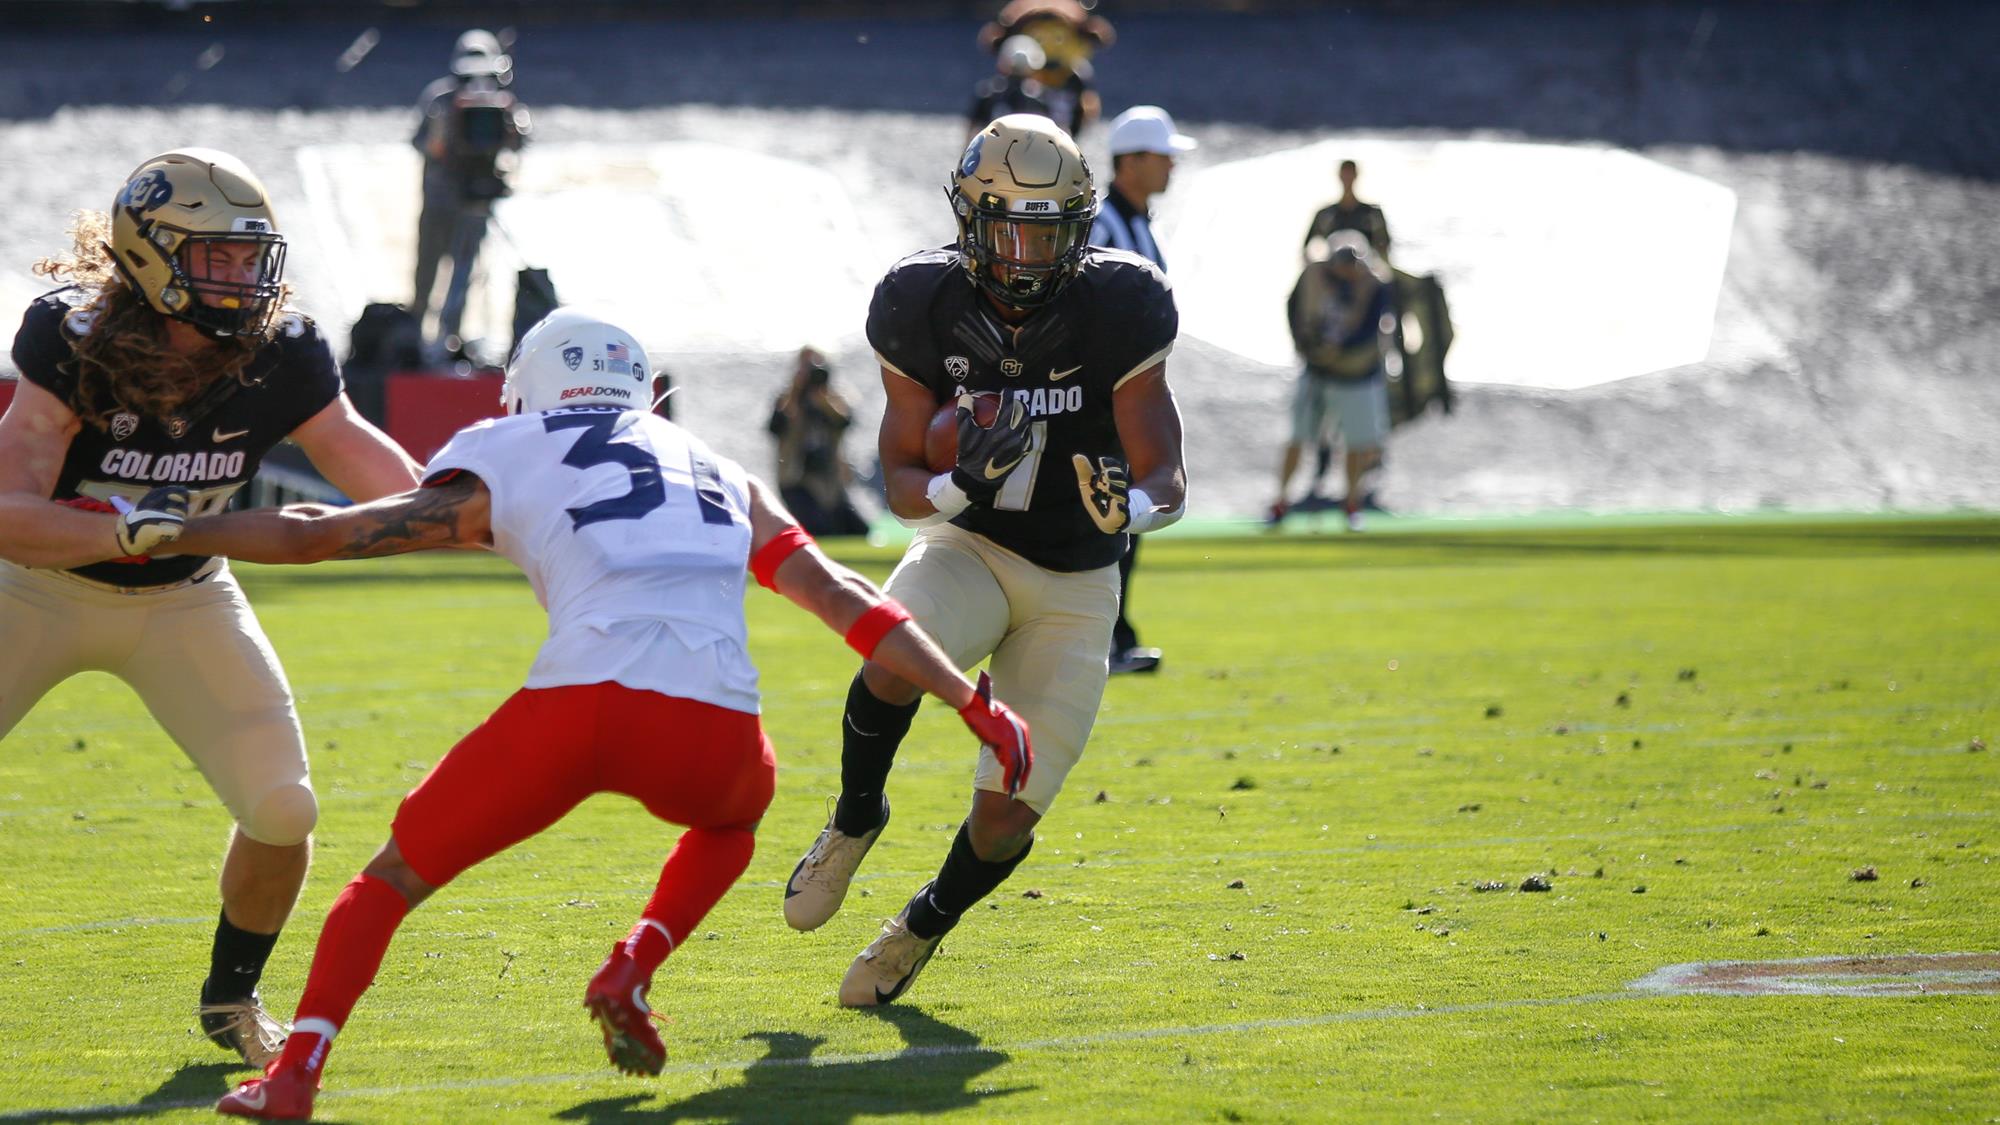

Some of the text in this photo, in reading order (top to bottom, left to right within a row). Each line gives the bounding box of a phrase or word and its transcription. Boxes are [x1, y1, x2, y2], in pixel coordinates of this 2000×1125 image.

[1025, 202, 1049, 212] BUFFS
[592, 359, 605, 372] 31
[100, 448, 246, 483] COLORADO
[542, 411, 734, 533] 31
